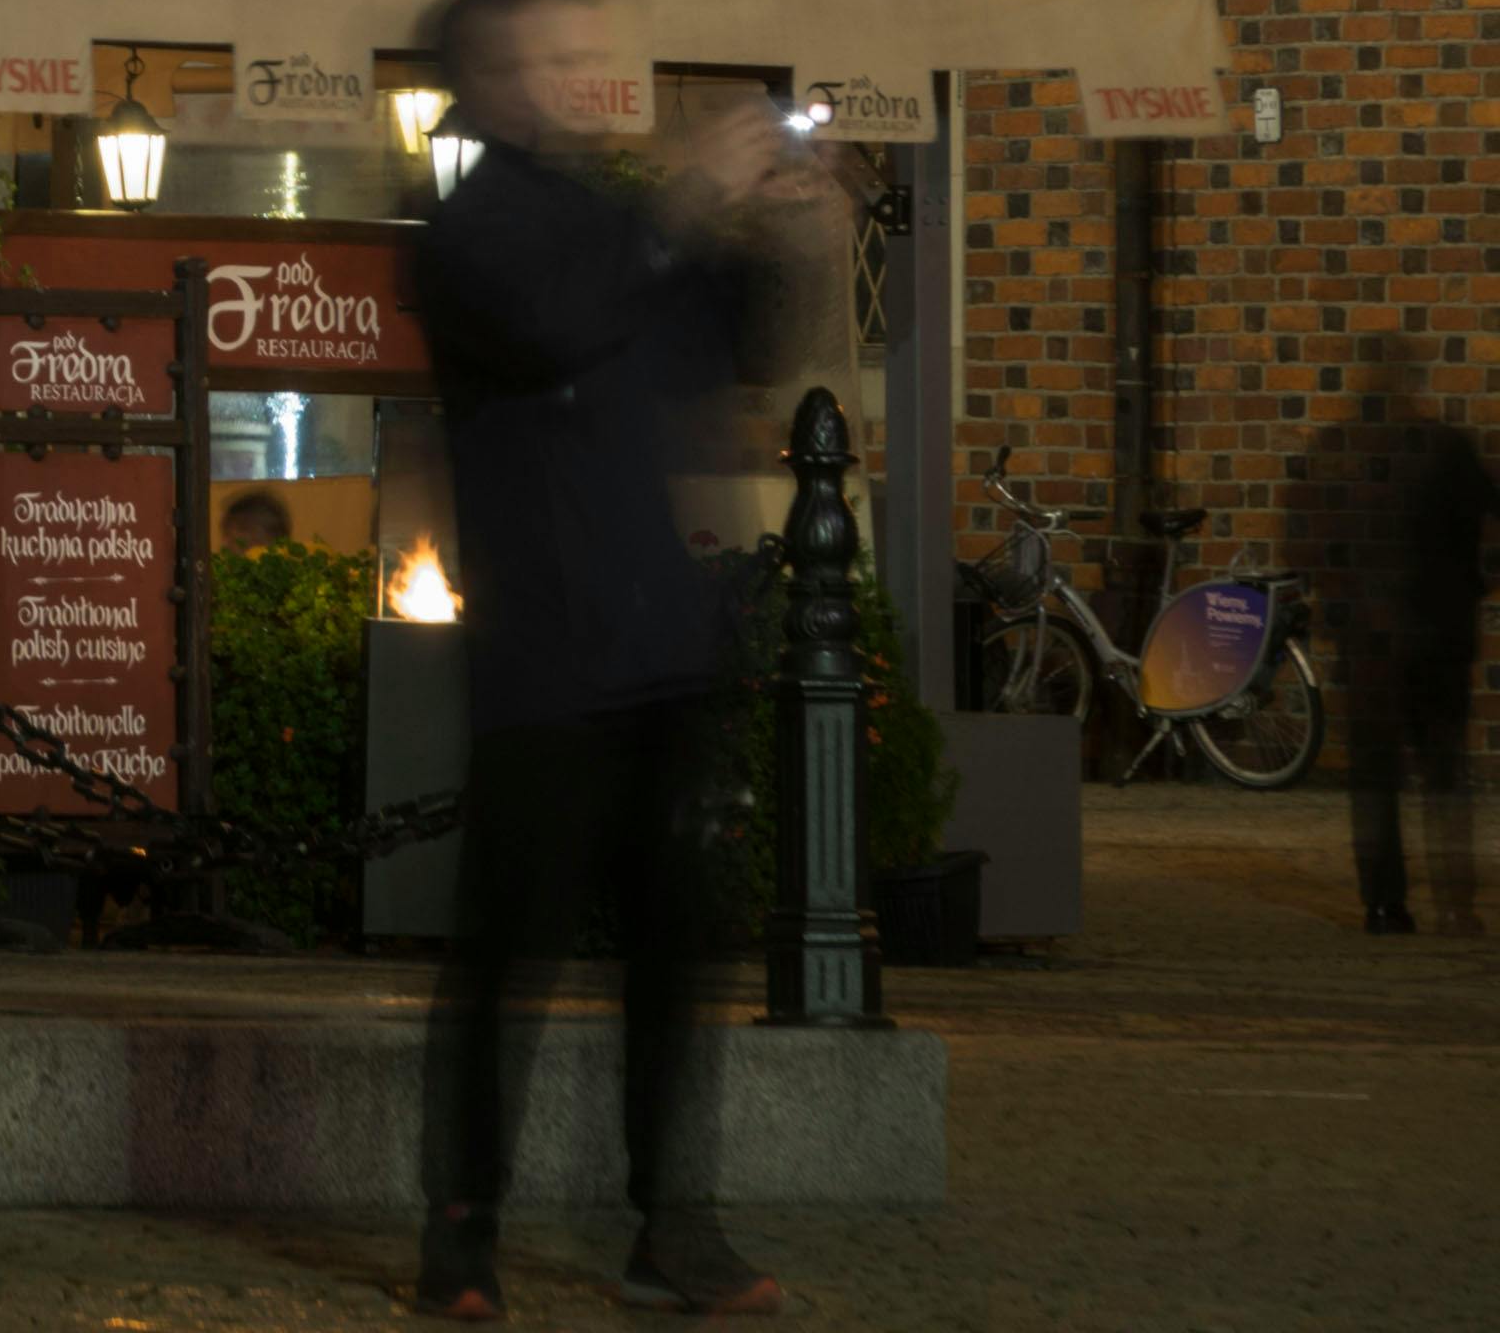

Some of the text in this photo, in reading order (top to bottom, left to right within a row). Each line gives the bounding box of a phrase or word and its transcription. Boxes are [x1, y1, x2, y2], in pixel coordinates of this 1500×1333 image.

[1094, 86, 1216, 121] TYSKIE
[276, 251, 315, 291] pod
[52, 329, 78, 353] pod
[256, 337, 379, 364] RESTAURACJA
[30, 384, 147, 407] RESTAURACJA
[13, 490, 137, 531] Tradycyjna
[0, 526, 153, 569] kuchnia polska
[18, 594, 138, 631] Traditional
[12, 628, 146, 670] polish cuisine
[91, 744, 166, 785] Küche
